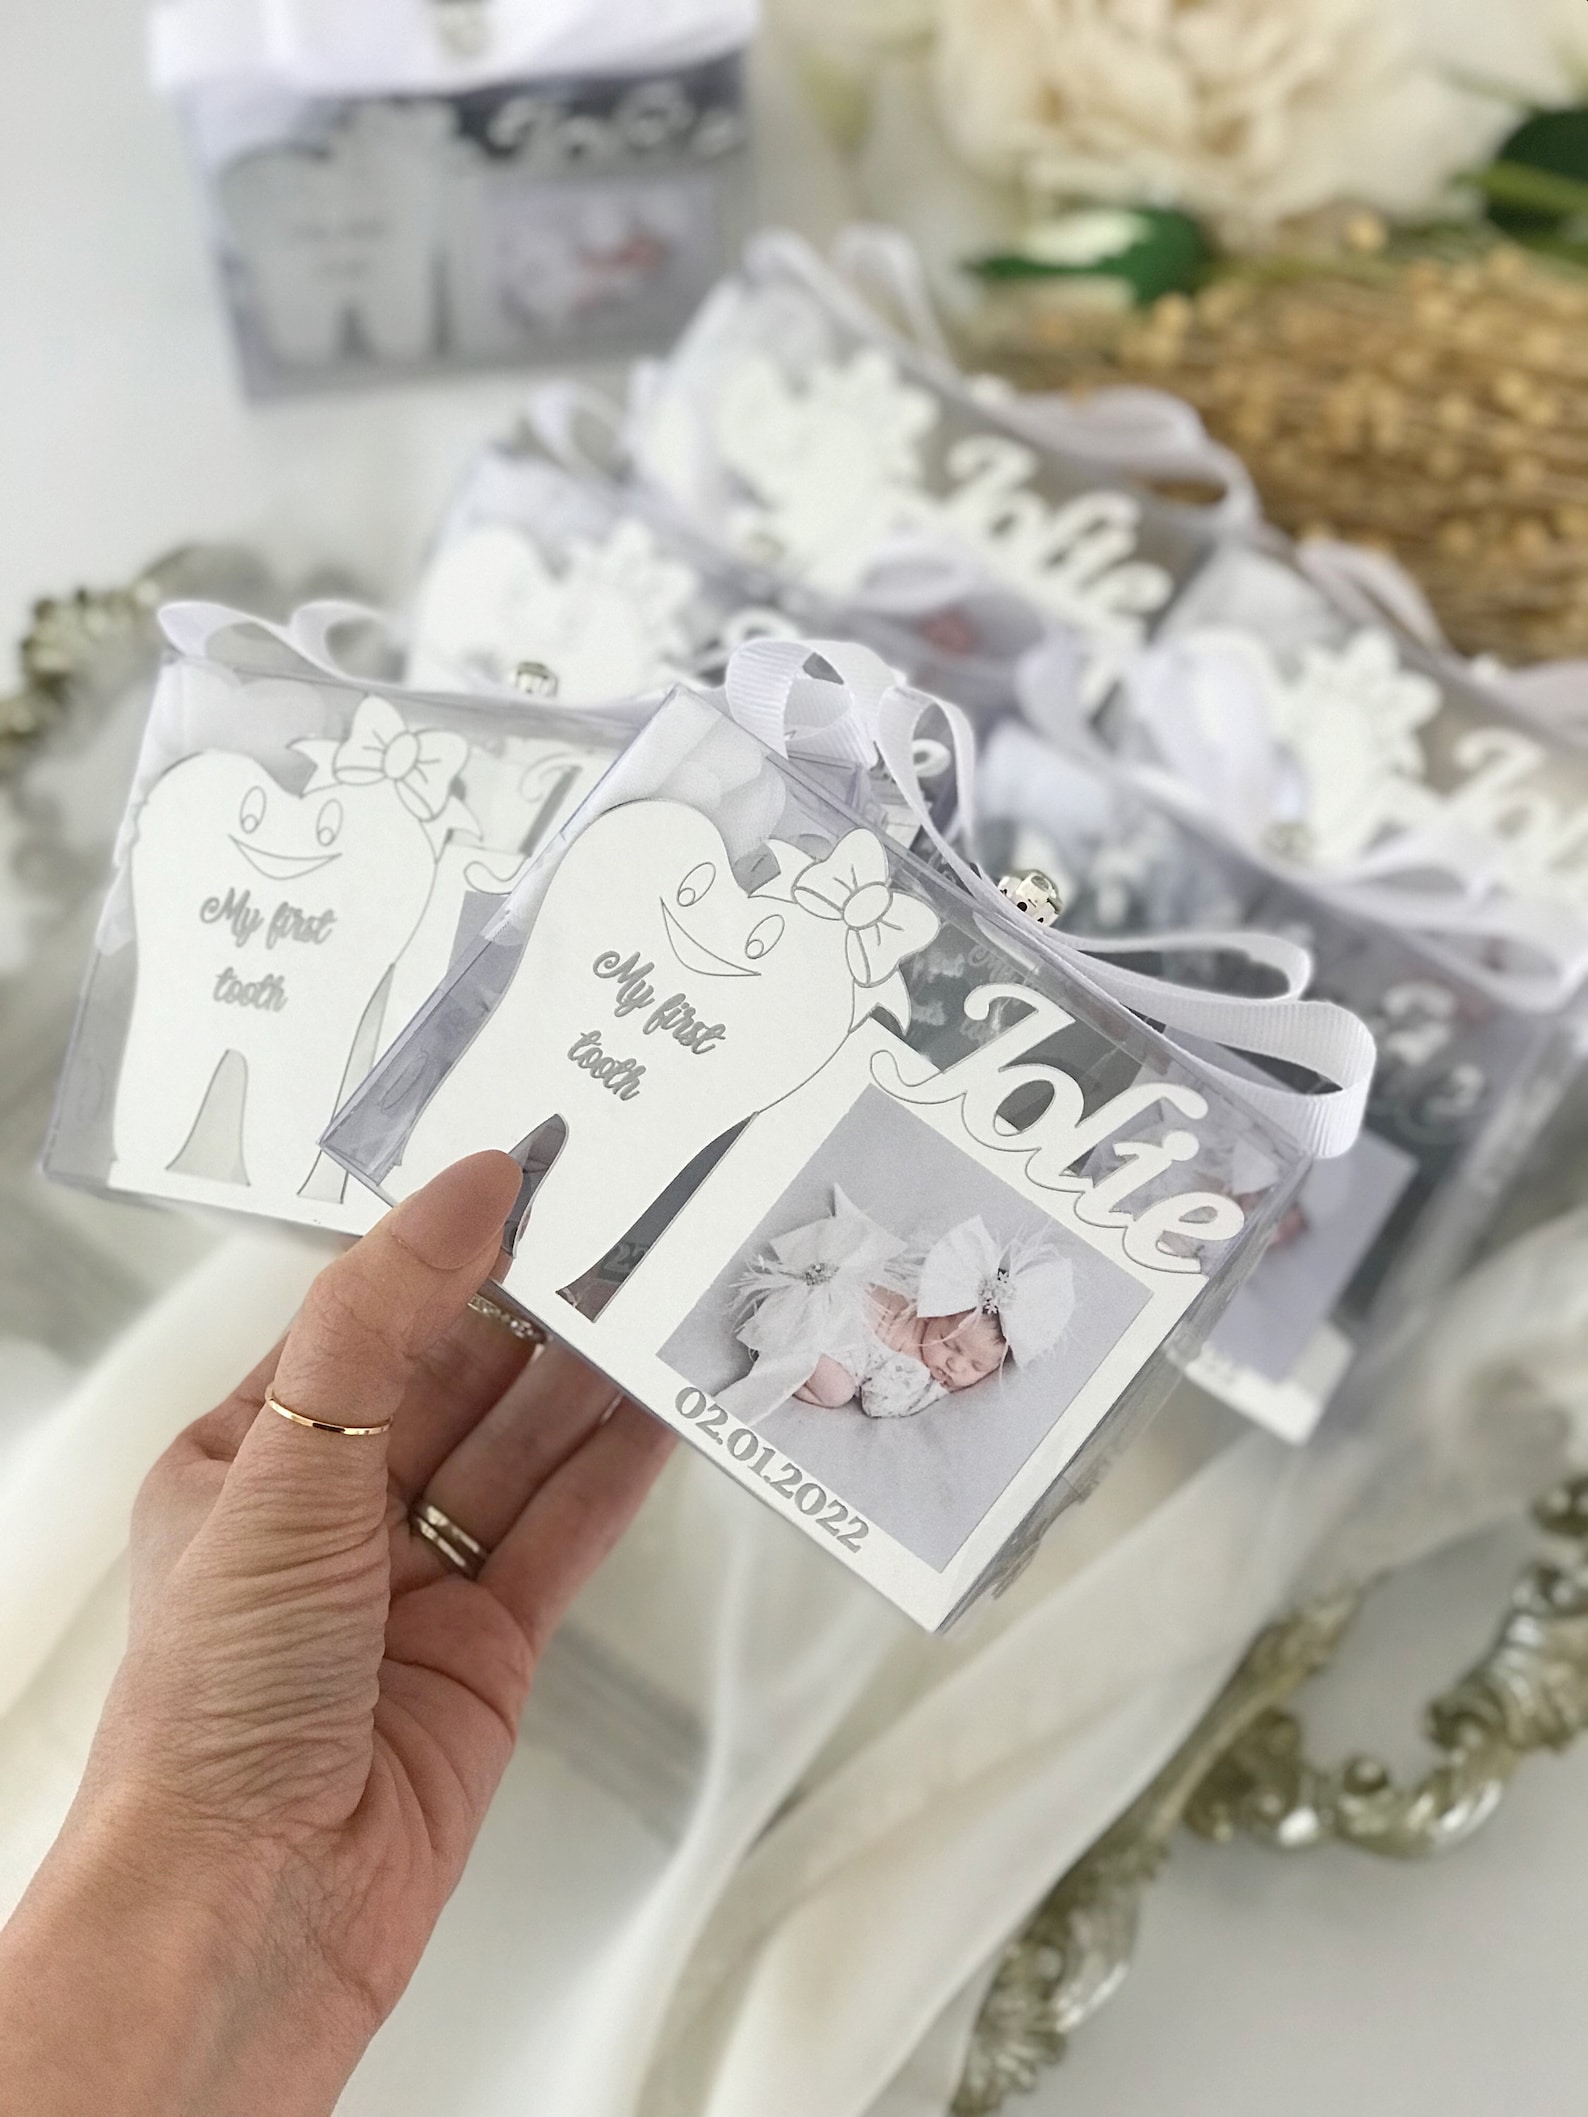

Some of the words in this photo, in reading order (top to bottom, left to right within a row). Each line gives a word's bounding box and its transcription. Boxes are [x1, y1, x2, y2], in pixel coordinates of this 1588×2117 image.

[199, 887, 265, 949] My
[265, 901, 338, 950] first
[212, 966, 289, 1013] tooth
[592, 950, 656, 1018] My
[642, 992, 727, 1055] first
[567, 1029, 647, 1101] tooth
[870, 982, 1246, 1274] Jolie
[674, 1386, 869, 1554] 02.01.2022
